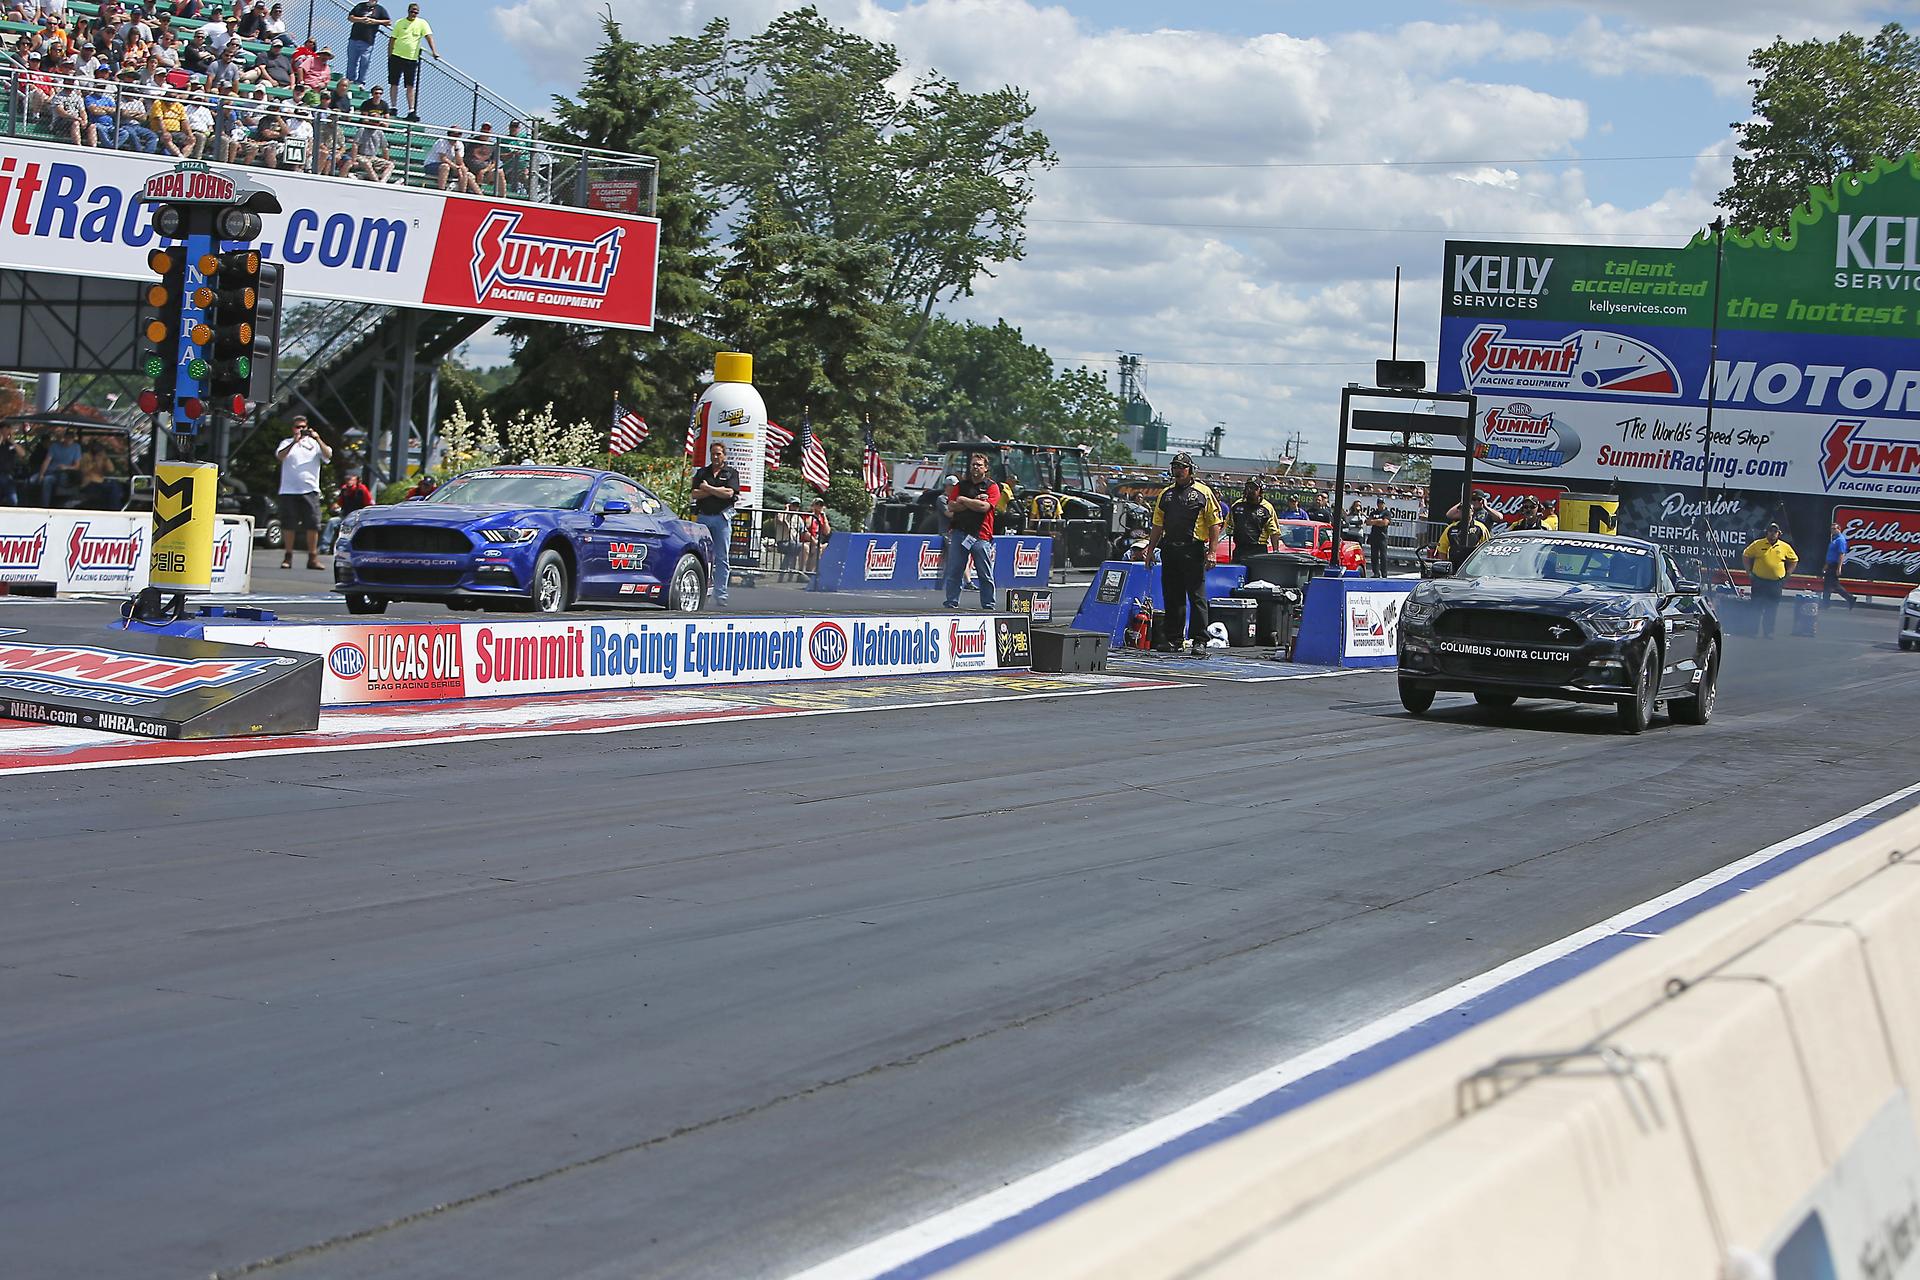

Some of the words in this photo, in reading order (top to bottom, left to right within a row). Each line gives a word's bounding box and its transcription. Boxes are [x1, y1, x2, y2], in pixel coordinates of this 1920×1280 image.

[181, 162, 205, 170] PIZZA
[147, 173, 184, 197] PAPA
[0, 157, 408, 273] itRac.com
[1454, 255, 1554, 294] KELLY
[1605, 260, 1675, 277] talent
[1571, 278, 1708, 296] accelerated
[491, 288, 535, 302] RACING
[537, 293, 603, 310] EQUIPMENT
[1453, 295, 1538, 308] SERVICES
[1589, 300, 1687, 315] kellyservices.com
[1728, 297, 1778, 319] the
[1786, 300, 1908, 324] hottest
[1480, 378, 1514, 386] RACING
[1516, 379, 1570, 388] EQUIPMENT
[1509, 404, 1532, 415] NHRA
[1616, 417, 1647, 442] The
[1652, 419, 1692, 442] World's
[1737, 429, 1770, 454] Shop
[1488, 443, 1520, 464] Drag
[1520, 446, 1564, 467] Racing
[1516, 458, 1553, 467] LEAGUE
[1597, 445, 1788, 478] SummitRacing.com
[1838, 482, 1883, 492] RACING
[1390, 507, 1417, 521] Sharp
[1532, 538, 1648, 556] PERFORMANCE
[1, 573, 38, 581] EQUIPMENT
[76, 574, 97, 582] RACING
[99, 574, 134, 582] EQUIPMENT
[475, 626, 584, 684] Summit
[590, 624, 679, 680] Racing
[684, 624, 803, 676] Equipment
[813, 631, 846, 663] NHRA
[851, 622, 939, 667] Nationals
[1440, 642, 1492, 655] COLUMBUS
[1530, 650, 1570, 661] CLUTCH
[331, 647, 364, 675] NHRA
[367, 633, 429, 682] LUCAS
[432, 631, 461, 680] OIL
[367, 683, 394, 691] DRAG
[395, 682, 430, 690] RACING
[431, 680, 461, 689] SERIES
[10, 702, 78, 725] NHRA.com
[99, 713, 168, 738] NHRA.com
